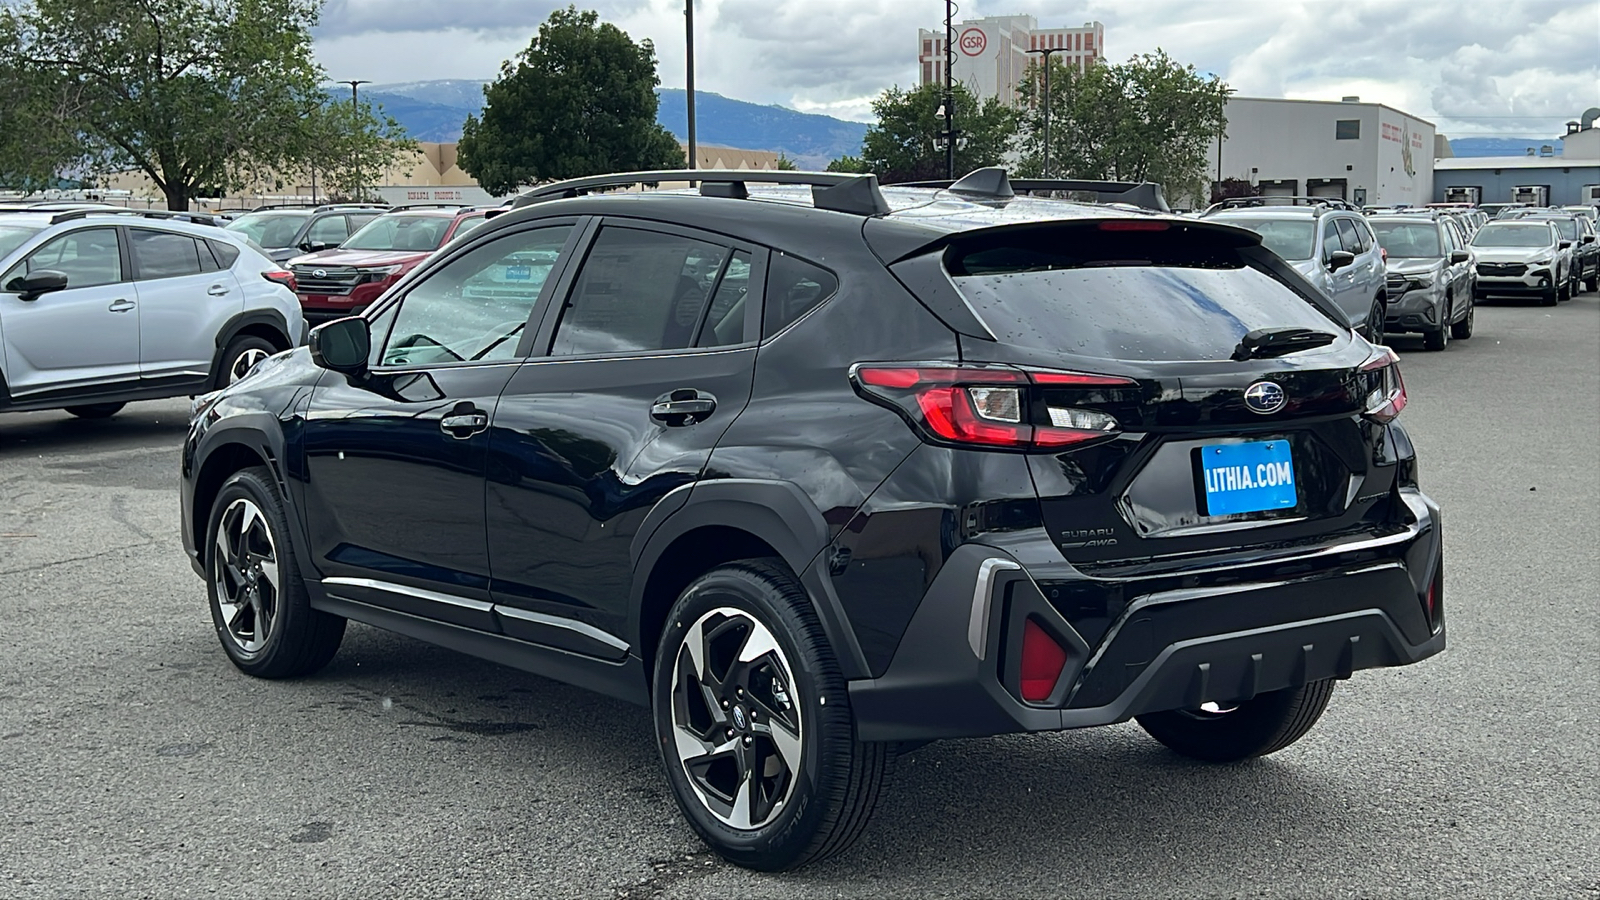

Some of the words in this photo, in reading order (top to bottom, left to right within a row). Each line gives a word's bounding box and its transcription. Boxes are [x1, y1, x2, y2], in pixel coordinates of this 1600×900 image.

[963, 36, 982, 49] GSR
[1206, 461, 1292, 493] LITHIA.COM
[1061, 528, 1114, 538] SUBARU
[1084, 538, 1118, 547] AWD
